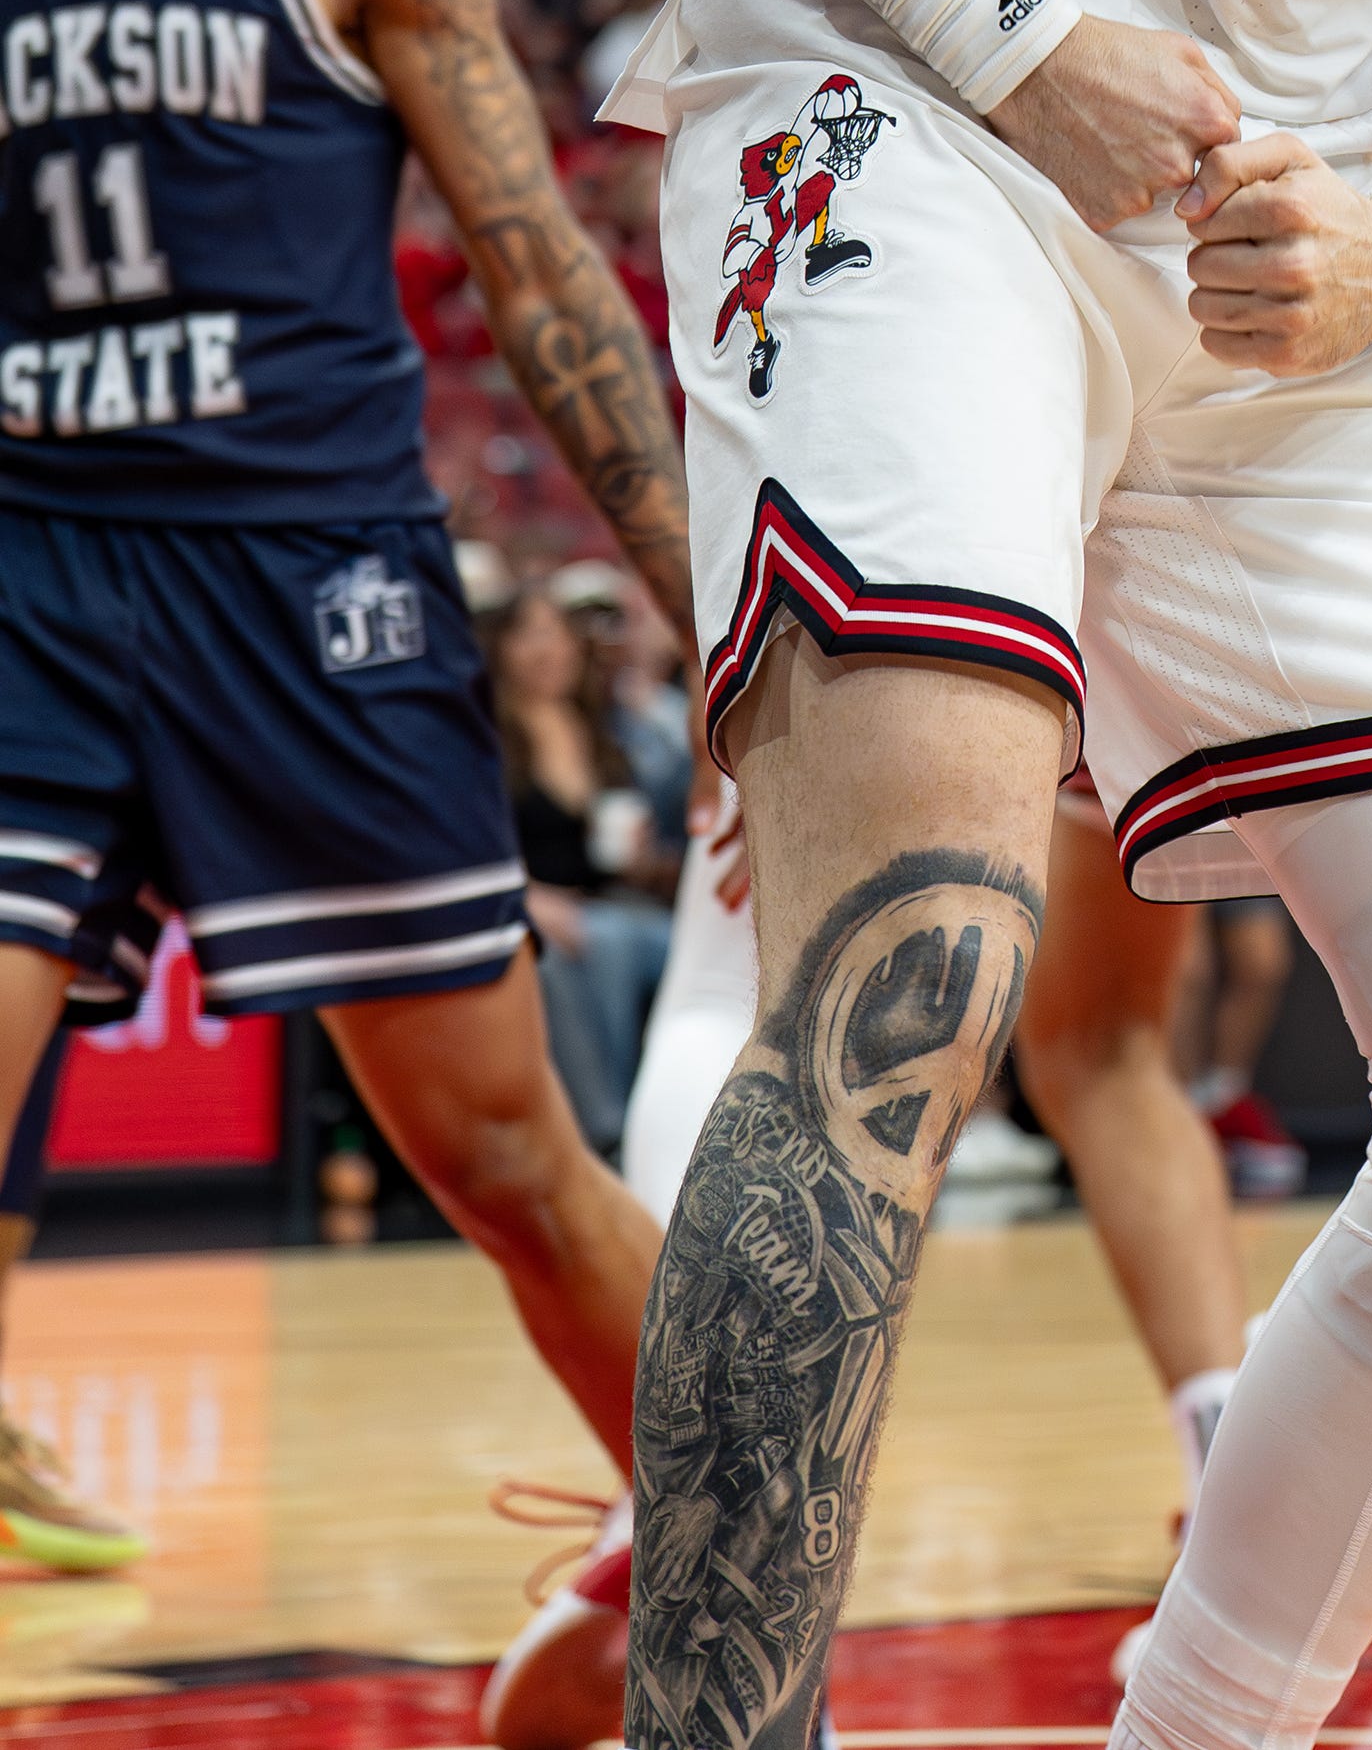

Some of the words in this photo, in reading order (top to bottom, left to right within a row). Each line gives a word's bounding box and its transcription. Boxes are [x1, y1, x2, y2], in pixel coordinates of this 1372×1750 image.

[5, 0, 269, 128] CKSON
[33, 142, 172, 310] 11
[0, 310, 248, 439] STATE
[723, 1184, 818, 1317] Team
[802, 1487, 842, 1570] 8
